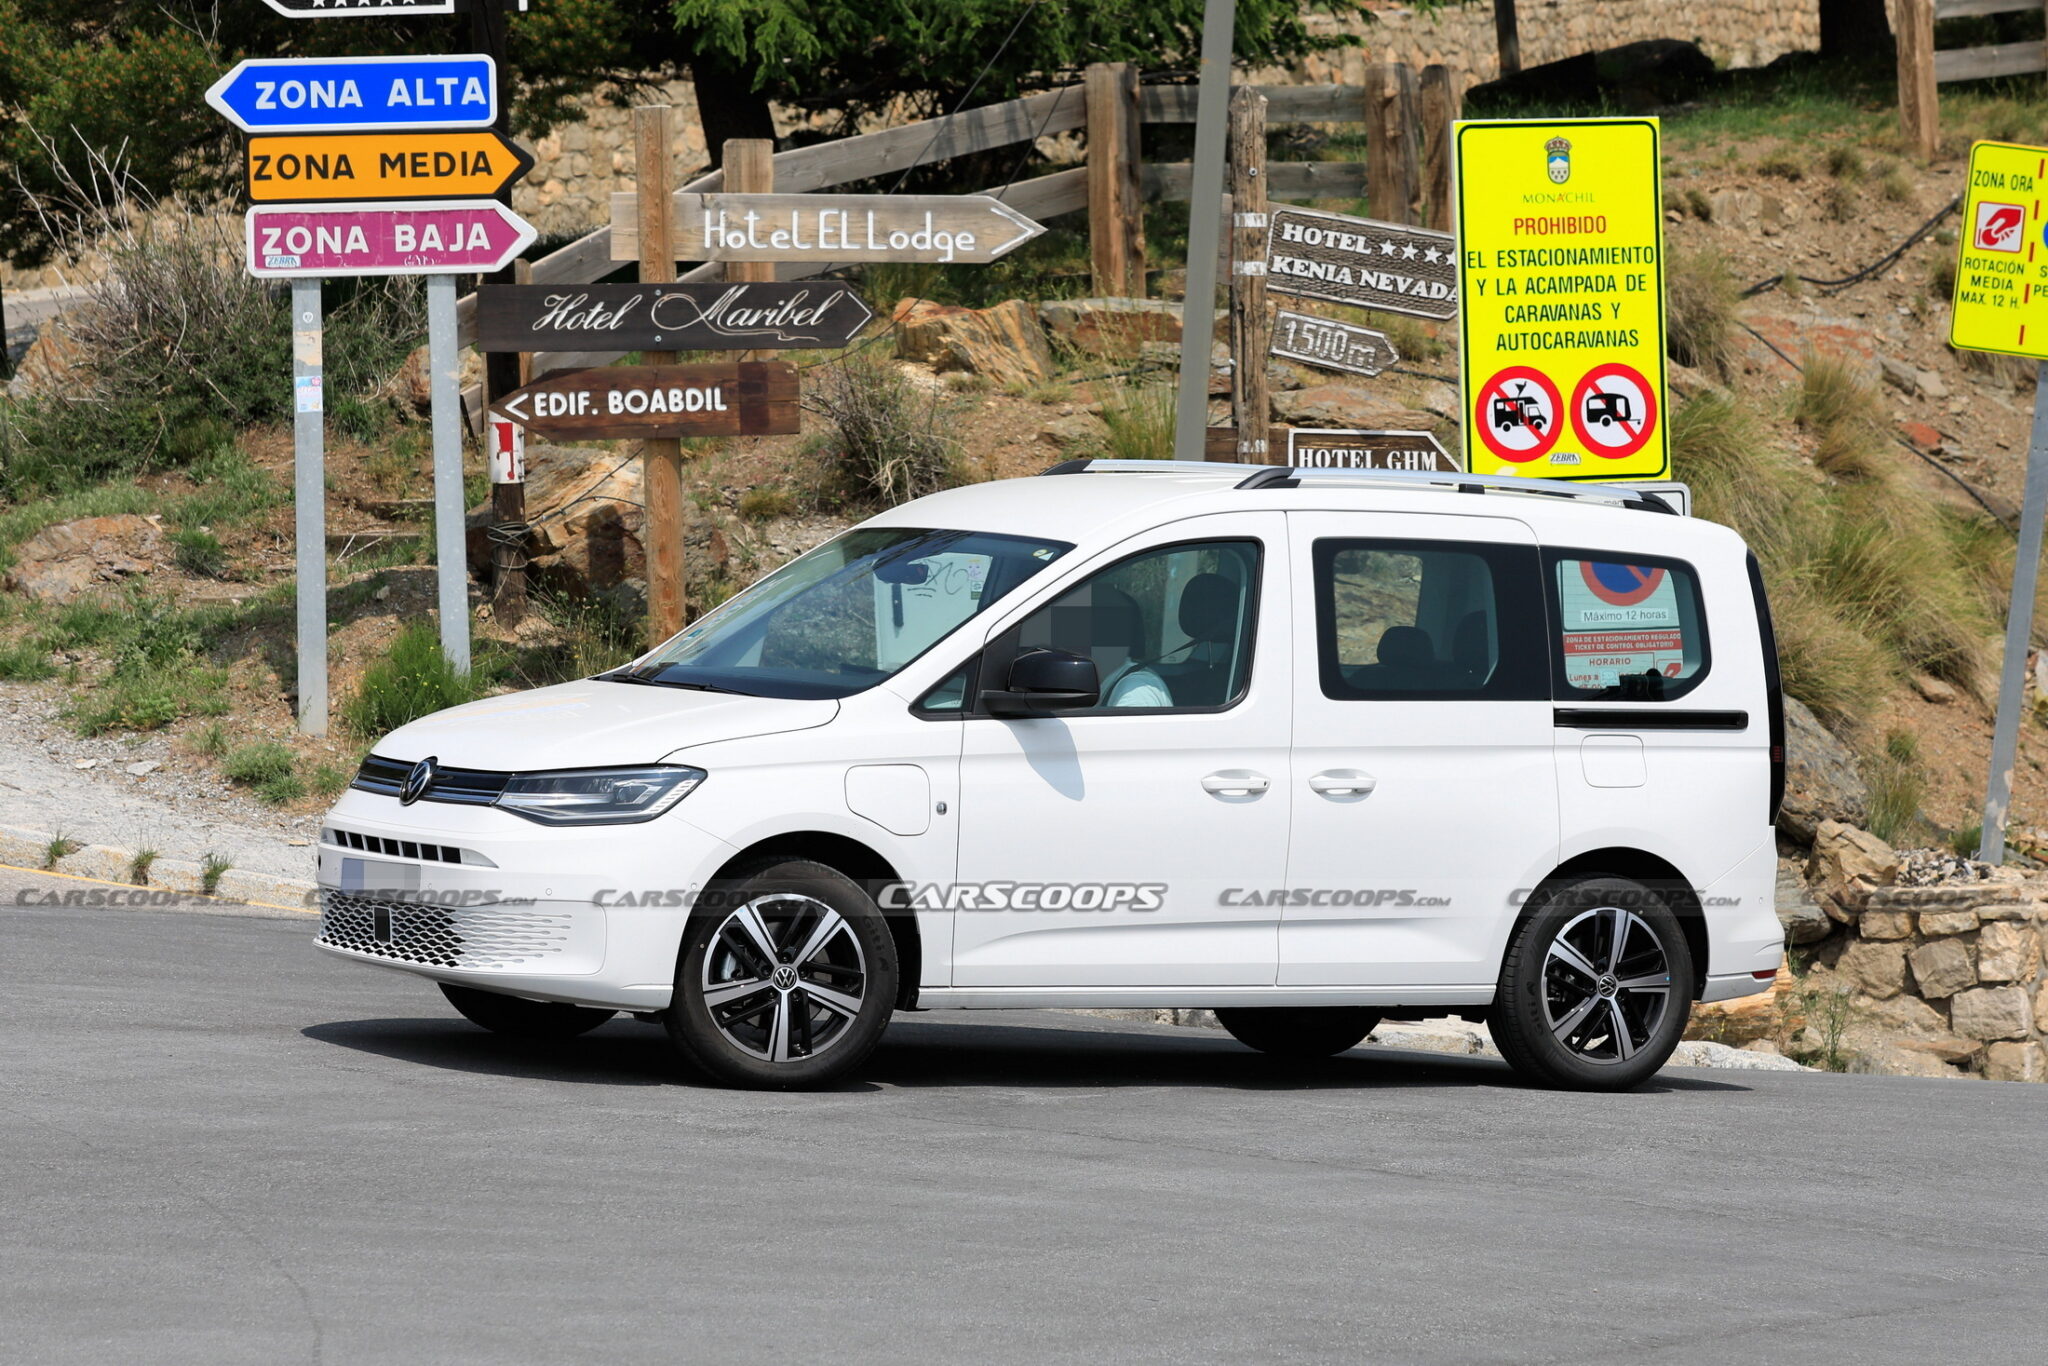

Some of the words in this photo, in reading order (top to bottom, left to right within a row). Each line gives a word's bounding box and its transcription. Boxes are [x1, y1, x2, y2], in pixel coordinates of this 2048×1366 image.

[255, 80, 363, 110] ZONA
[387, 77, 487, 106] ALTA
[253, 154, 355, 181] ZONA
[379, 151, 493, 178] MEDIA
[1974, 170, 2005, 189] ZONA
[2011, 174, 2033, 192] ORA
[704, 208, 812, 249] Hotel
[818, 209, 862, 249] EL
[867, 209, 977, 262] Lodge
[1514, 216, 1607, 236] PROHIBIDO
[262, 226, 370, 255] ZONA
[394, 223, 491, 252] BAJA
[1281, 223, 1372, 256] HOTEL
[1467, 251, 1487, 269] EL
[1497, 246, 1654, 268] ESTACIONAMIENTO
[1270, 255, 1354, 286] KENIA
[1476, 279, 1486, 296] Y
[1496, 278, 1517, 295] LA
[1525, 275, 1616, 294] ACAMPADA
[1626, 274, 1647, 292] DE
[1970, 276, 2014, 291] MEDIA
[1993, 295, 2005, 307] 12
[532, 293, 643, 331] Hotel
[651, 284, 845, 341] Maribel
[1505, 303, 1602, 323] CARAVANAS
[1611, 303, 1620, 320] Y
[1496, 329, 1639, 351] AUTOCARAVANAS
[534, 393, 598, 417] EDIF.
[608, 386, 728, 415] BOABDIL
[1298, 448, 1379, 468] HOTEL
[1386, 450, 1437, 470] GHM
[1584, 611, 1622, 622] Máximo
[1625, 611, 1637, 620] 12
[1640, 609, 1666, 619] horas
[1589, 657, 1631, 666] HORARIO
[1569, 674, 1592, 682] Lunes
